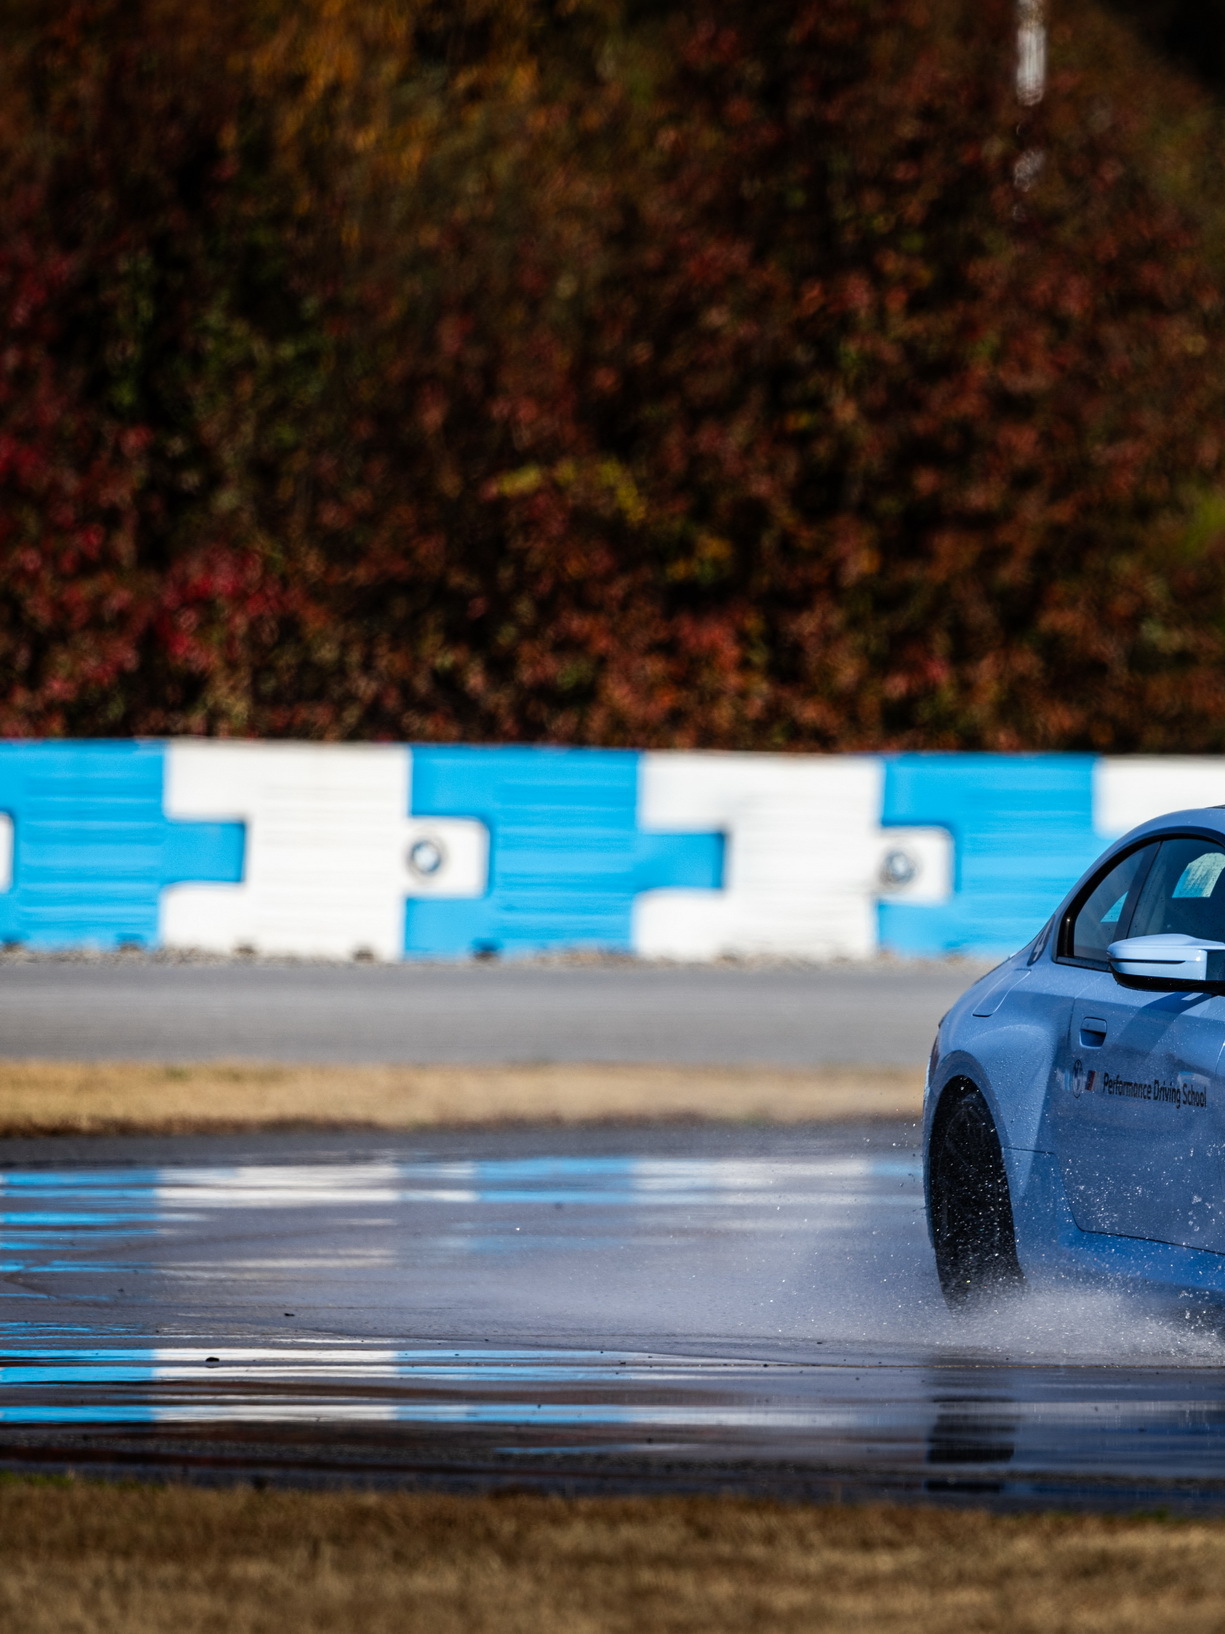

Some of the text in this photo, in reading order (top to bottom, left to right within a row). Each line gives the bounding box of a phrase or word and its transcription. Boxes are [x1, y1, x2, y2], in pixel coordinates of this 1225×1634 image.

[1102, 1072, 1207, 1109] Performance Driving School
